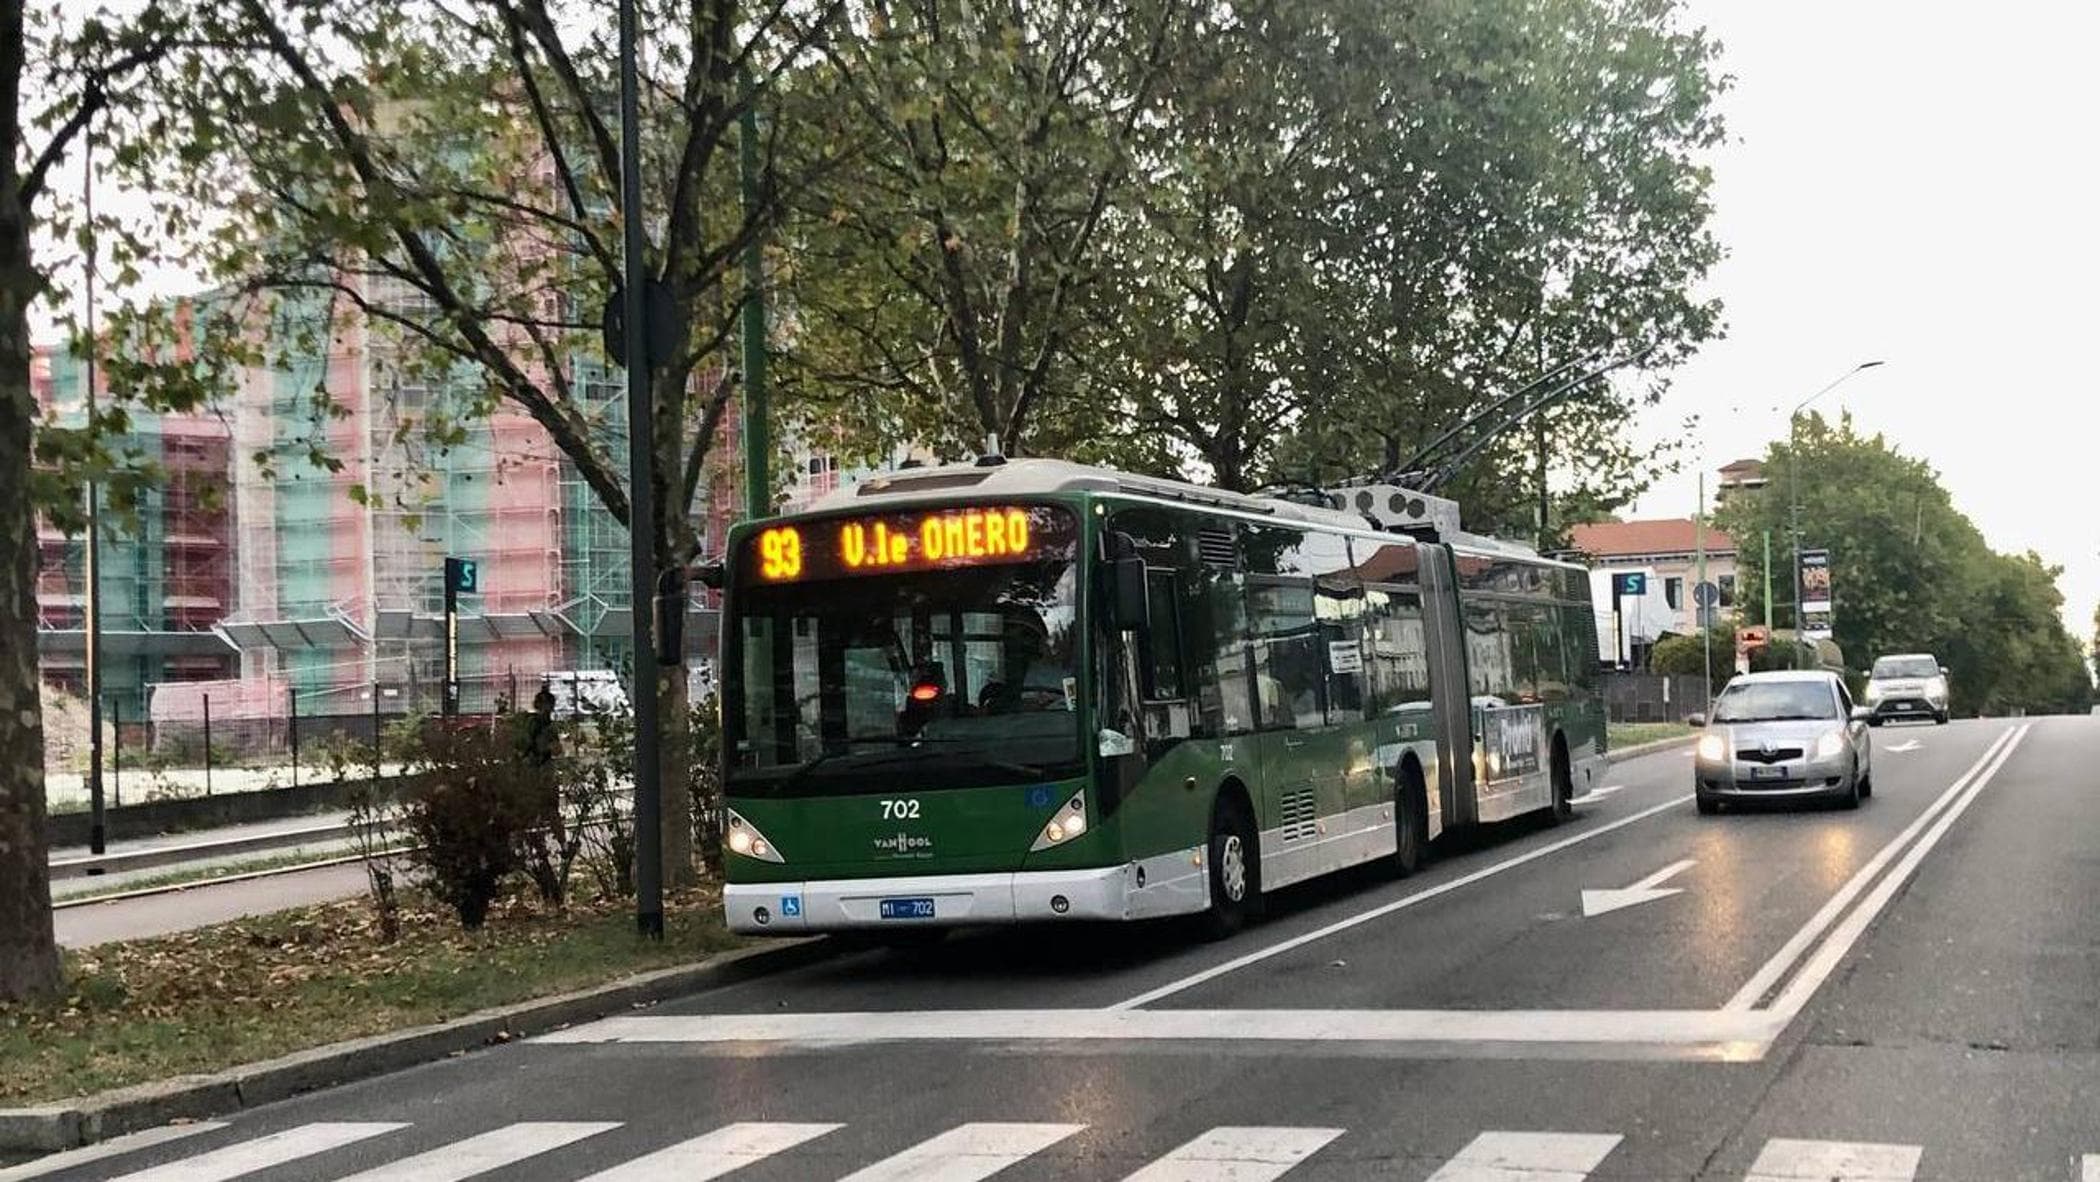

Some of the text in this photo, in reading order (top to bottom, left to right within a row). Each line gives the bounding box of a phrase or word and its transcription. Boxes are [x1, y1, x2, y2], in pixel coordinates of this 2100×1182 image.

[761, 526, 801, 579] 93
[921, 509, 1030, 560] OMERO
[461, 564, 473, 587] S
[1627, 575, 1641, 592] S
[880, 799, 920, 819] 702
[912, 901, 933, 914] 702
